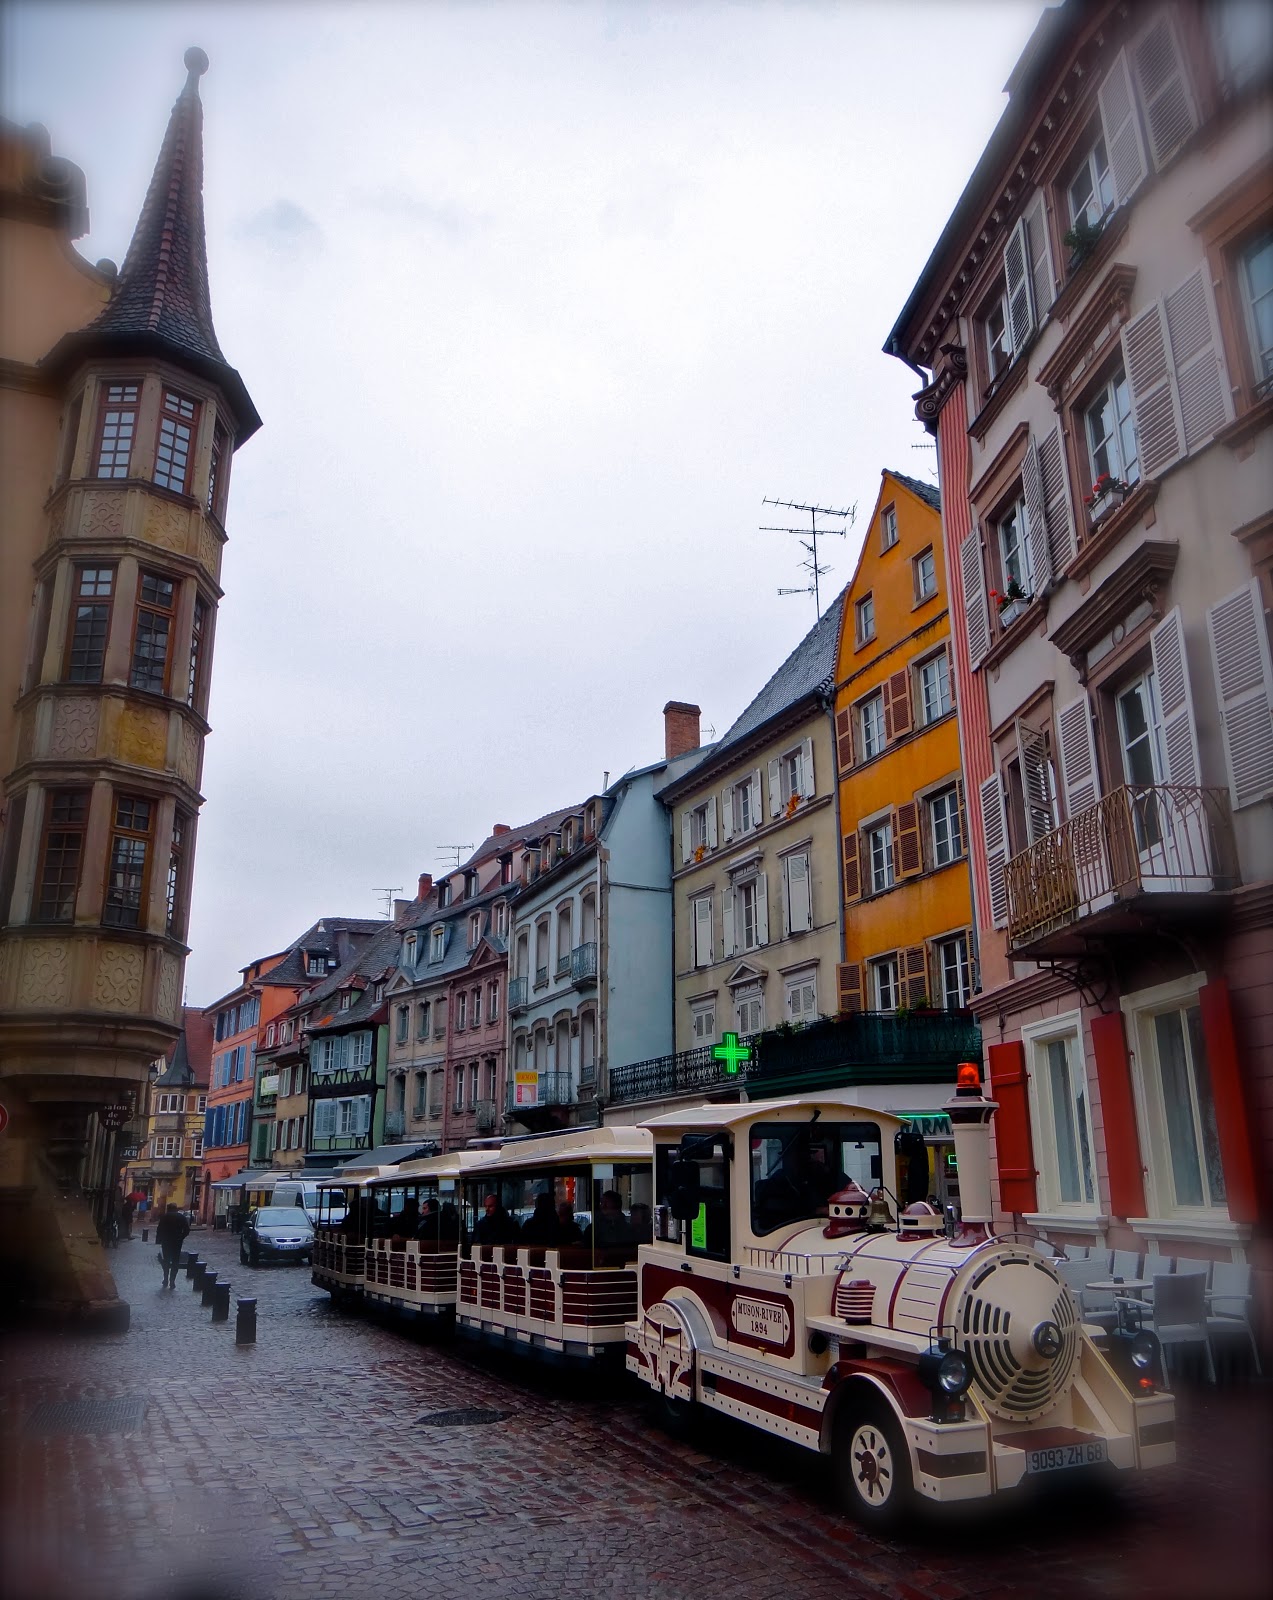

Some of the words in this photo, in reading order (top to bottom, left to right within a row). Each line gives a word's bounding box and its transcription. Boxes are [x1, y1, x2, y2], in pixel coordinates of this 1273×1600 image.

[901, 1118, 953, 1135] ARM
[751, 1320, 768, 1335] 1894
[1086, 1443, 1102, 1462] 68
